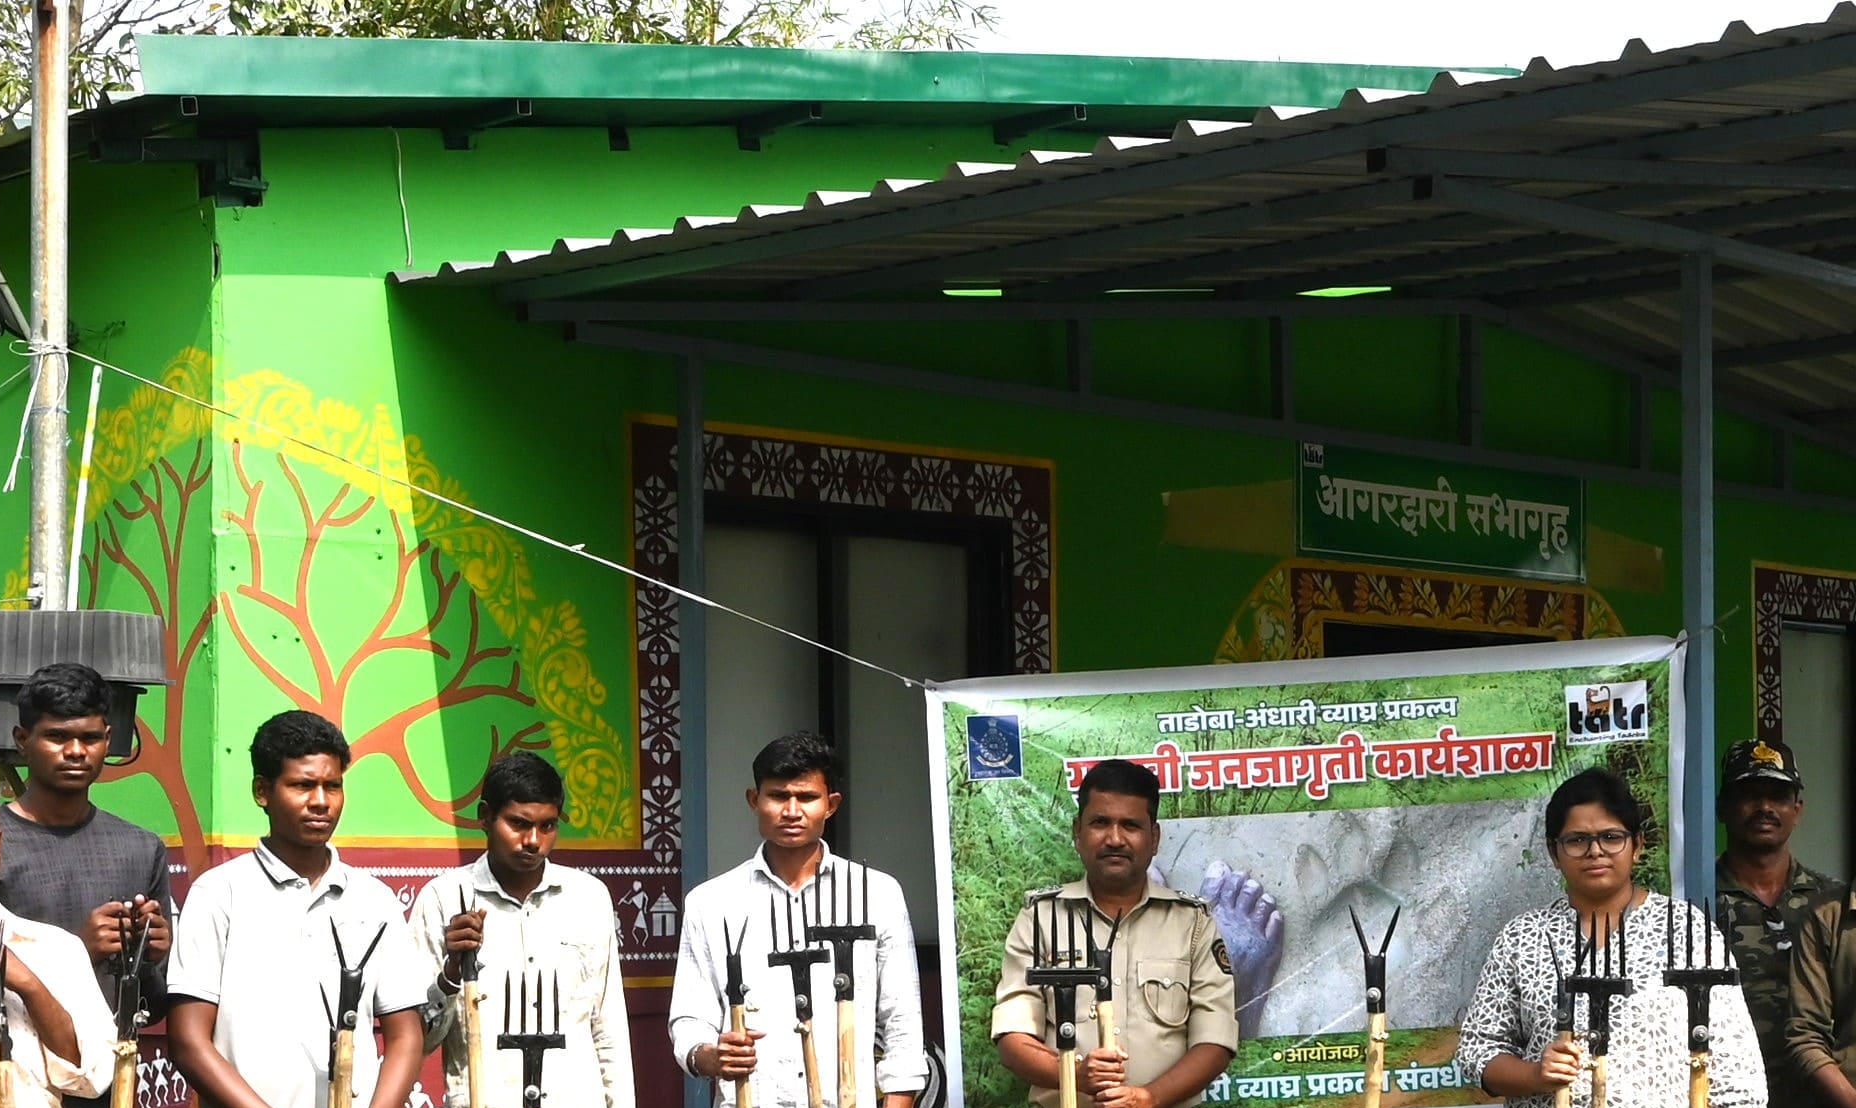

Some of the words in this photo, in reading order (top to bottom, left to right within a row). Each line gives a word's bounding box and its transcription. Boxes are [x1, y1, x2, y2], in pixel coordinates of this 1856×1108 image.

[1316, 474, 1457, 537] आगरझरी
[1466, 493, 1569, 559] सभागृह
[1156, 699, 1316, 733] ताडोबा-अंधारी
[1320, 702, 1378, 723] व्याघ्र
[1382, 697, 1458, 721] प्रकल्प
[1569, 697, 1645, 734] tatr
[1188, 733, 1365, 797] जनजागृती
[1373, 729, 1554, 780] कार्यशाळा
[1285, 1042, 1360, 1063] आयोजक
[1236, 1075, 1301, 1099] व्याघ्र
